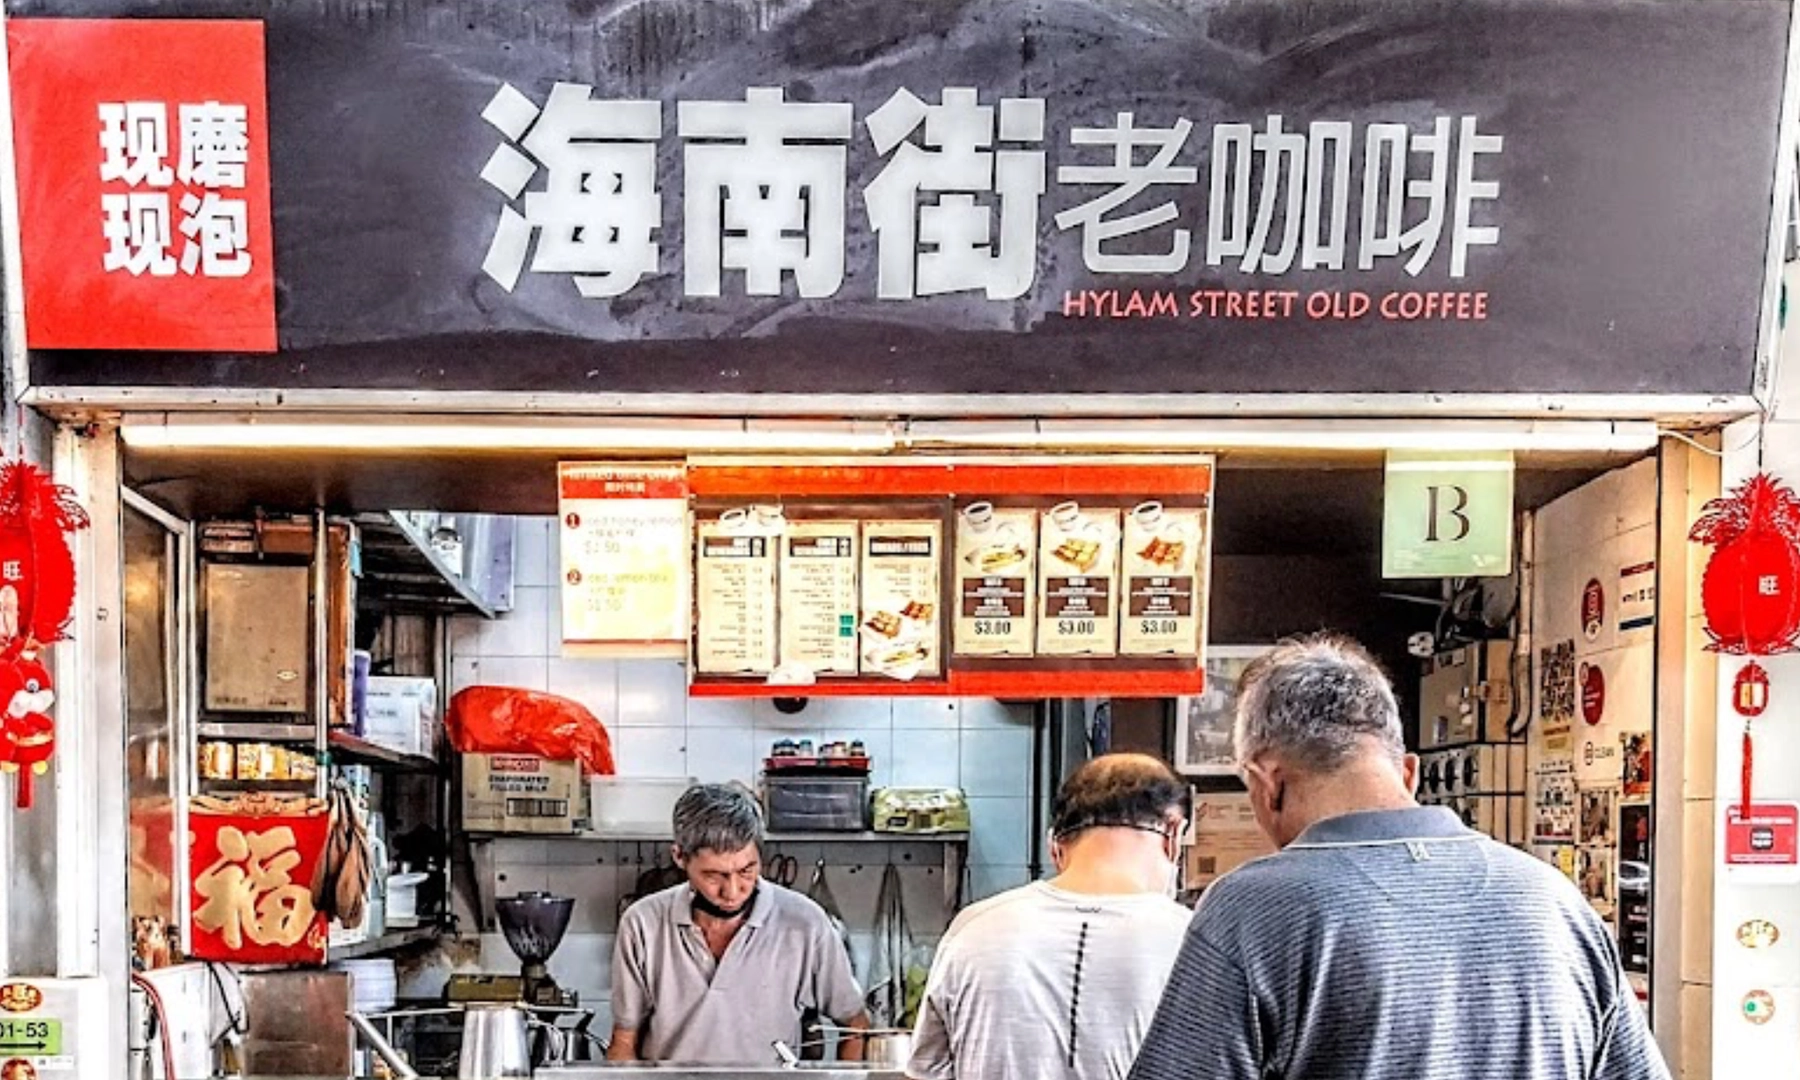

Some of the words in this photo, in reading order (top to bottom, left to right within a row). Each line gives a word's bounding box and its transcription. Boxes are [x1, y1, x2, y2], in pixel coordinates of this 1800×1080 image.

[97, 100, 250, 189] 现磨
[101, 191, 252, 278] 现泡
[1063, 289, 1179, 319] HYLAM
[1189, 290, 1298, 319] STREET
[1306, 290, 1370, 319] OLD
[1379, 291, 1489, 320] COFFEE
[1424, 484, 1471, 542] B
[974, 620, 1011, 635] $3.00
[1058, 620, 1095, 635] $3.00
[1141, 619, 1178, 634] $3.00
[192, 824, 317, 949] 福
